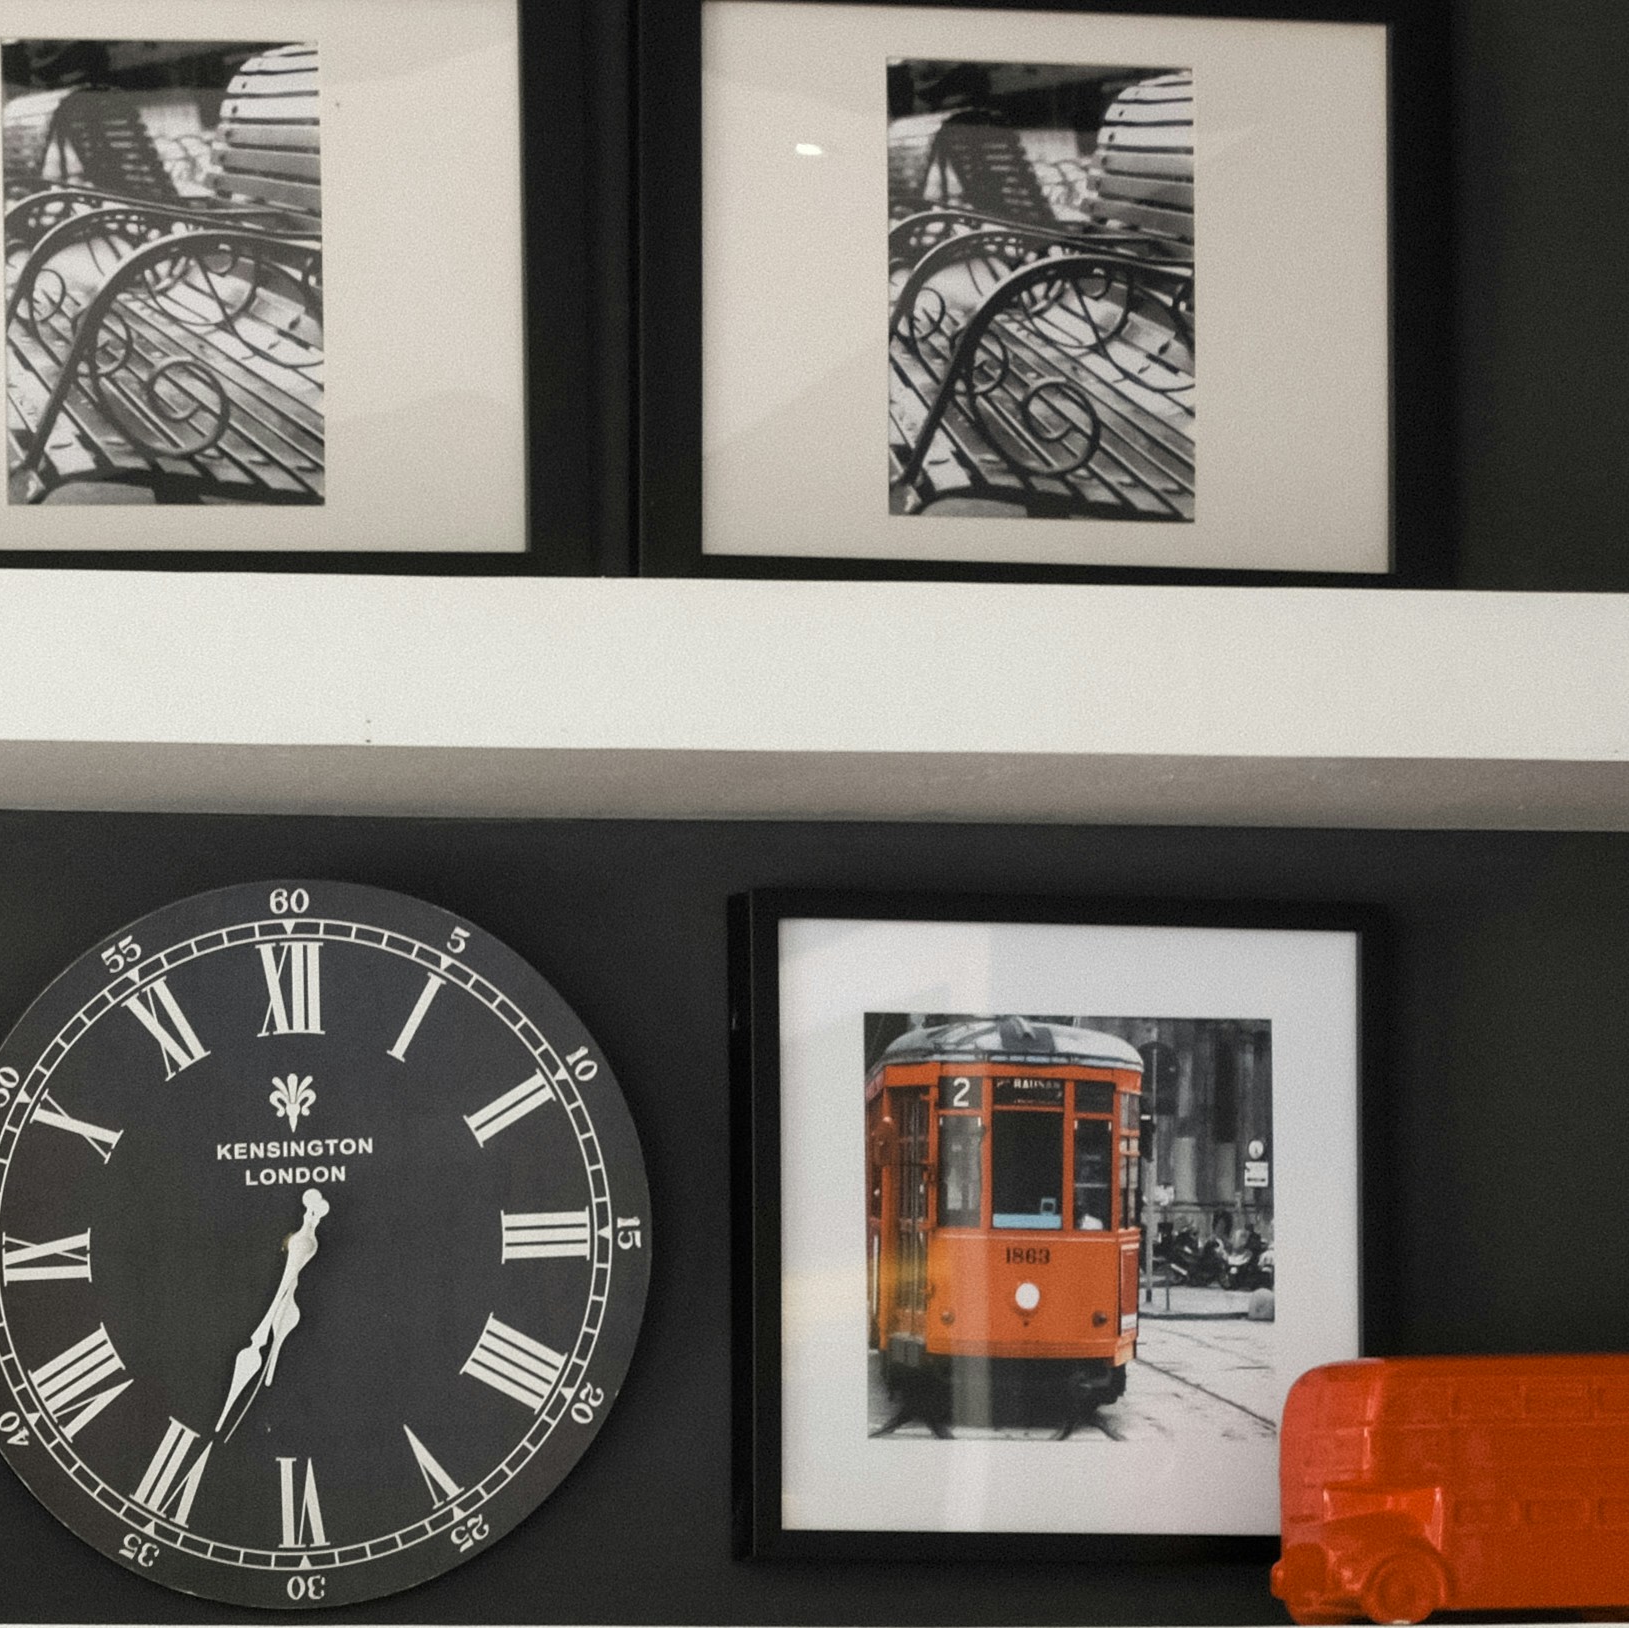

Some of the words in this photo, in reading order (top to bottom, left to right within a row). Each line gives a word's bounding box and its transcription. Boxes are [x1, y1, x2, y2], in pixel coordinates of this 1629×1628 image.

[269, 888, 310, 915] 60
[100, 934, 142, 974] 55
[446, 926, 471, 954] 5
[254, 941, 325, 1037] XII
[122, 976, 211, 1082] XI
[565, 1046, 598, 1082] 10
[464, 1069, 556, 1148] II
[952, 1077, 971, 1108] 2
[29, 1088, 124, 1164] X
[216, 1137, 374, 1161] KENSINGTON
[245, 1165, 346, 1186] LONDON
[501, 1208, 590, 1264] III
[616, 1216, 642, 1250] 15
[2, 1228, 92, 1286] IX
[28, 1323, 134, 1443] VIII
[460, 1313, 567, 1414] IIII
[571, 1382, 605, 1425] 20
[129, 1416, 212, 1528] VII
[403, 1424, 465, 1510] V
[275, 1457, 330, 1549] VI
[118, 1532, 161, 1567] 35
[450, 1513, 490, 1553] 25
[286, 1574, 326, 1601] 30
